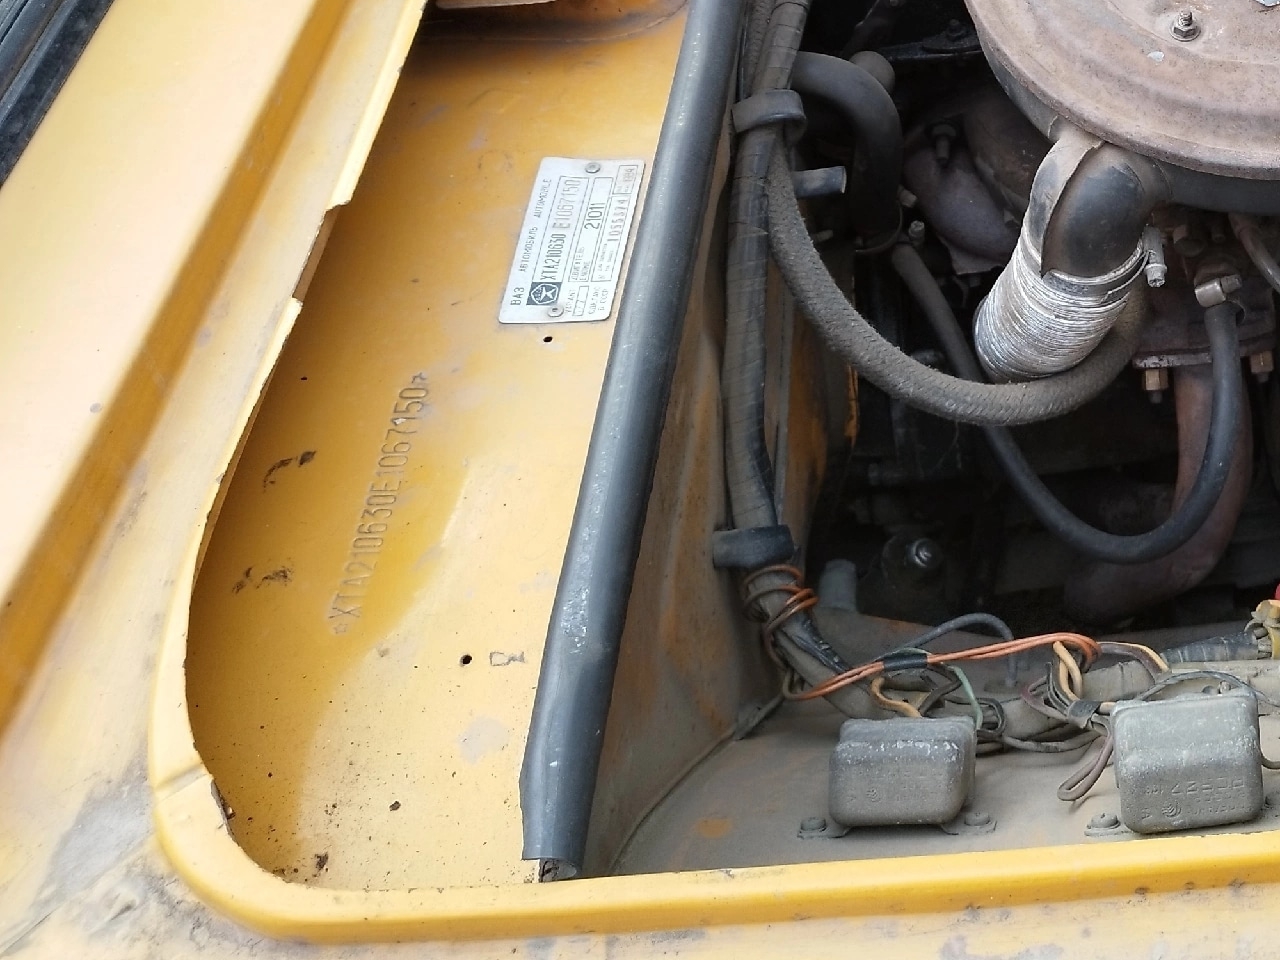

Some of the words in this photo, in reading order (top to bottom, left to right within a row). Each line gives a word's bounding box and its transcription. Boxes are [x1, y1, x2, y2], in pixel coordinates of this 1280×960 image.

[551, 179, 581, 228] E1067150
[583, 202, 605, 229] 21011
[539, 233, 566, 280] XTA210630
[509, 287, 525, 305] ВАЗ
